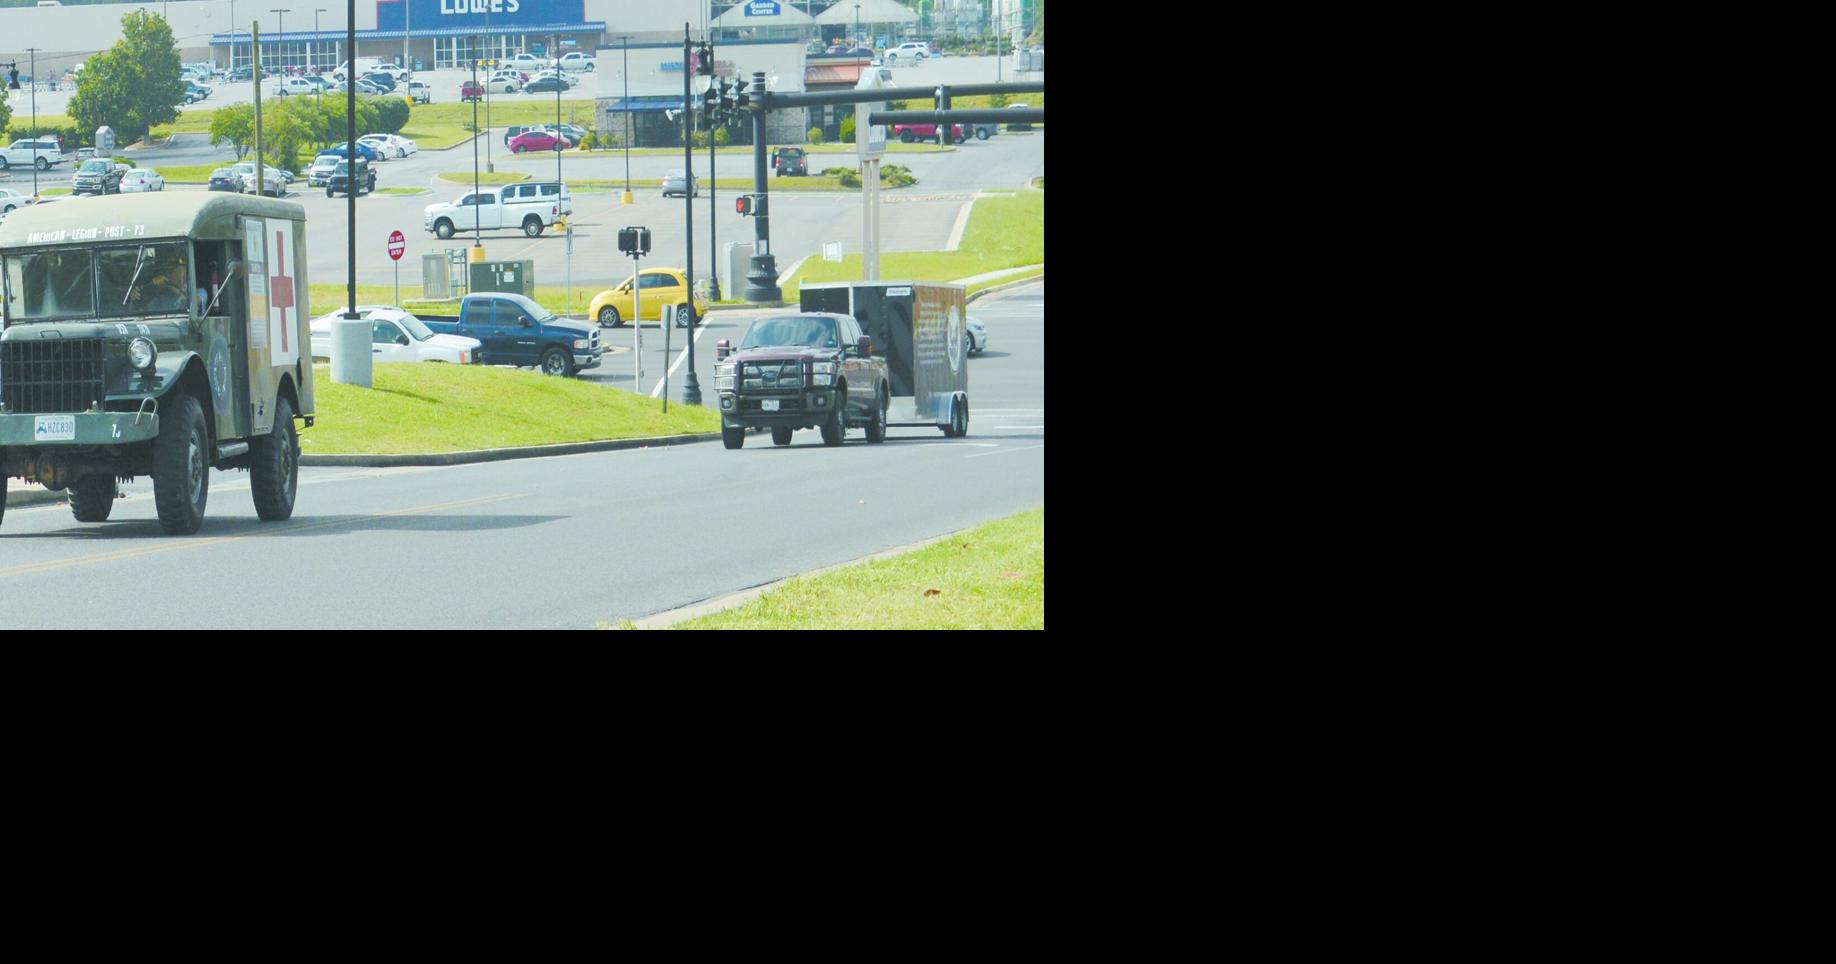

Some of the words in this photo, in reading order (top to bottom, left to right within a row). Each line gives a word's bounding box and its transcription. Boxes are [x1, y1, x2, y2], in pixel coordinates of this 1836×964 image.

[72, 228, 97, 240] LEGION
[104, 225, 125, 238] POST
[134, 225, 144, 235] 73
